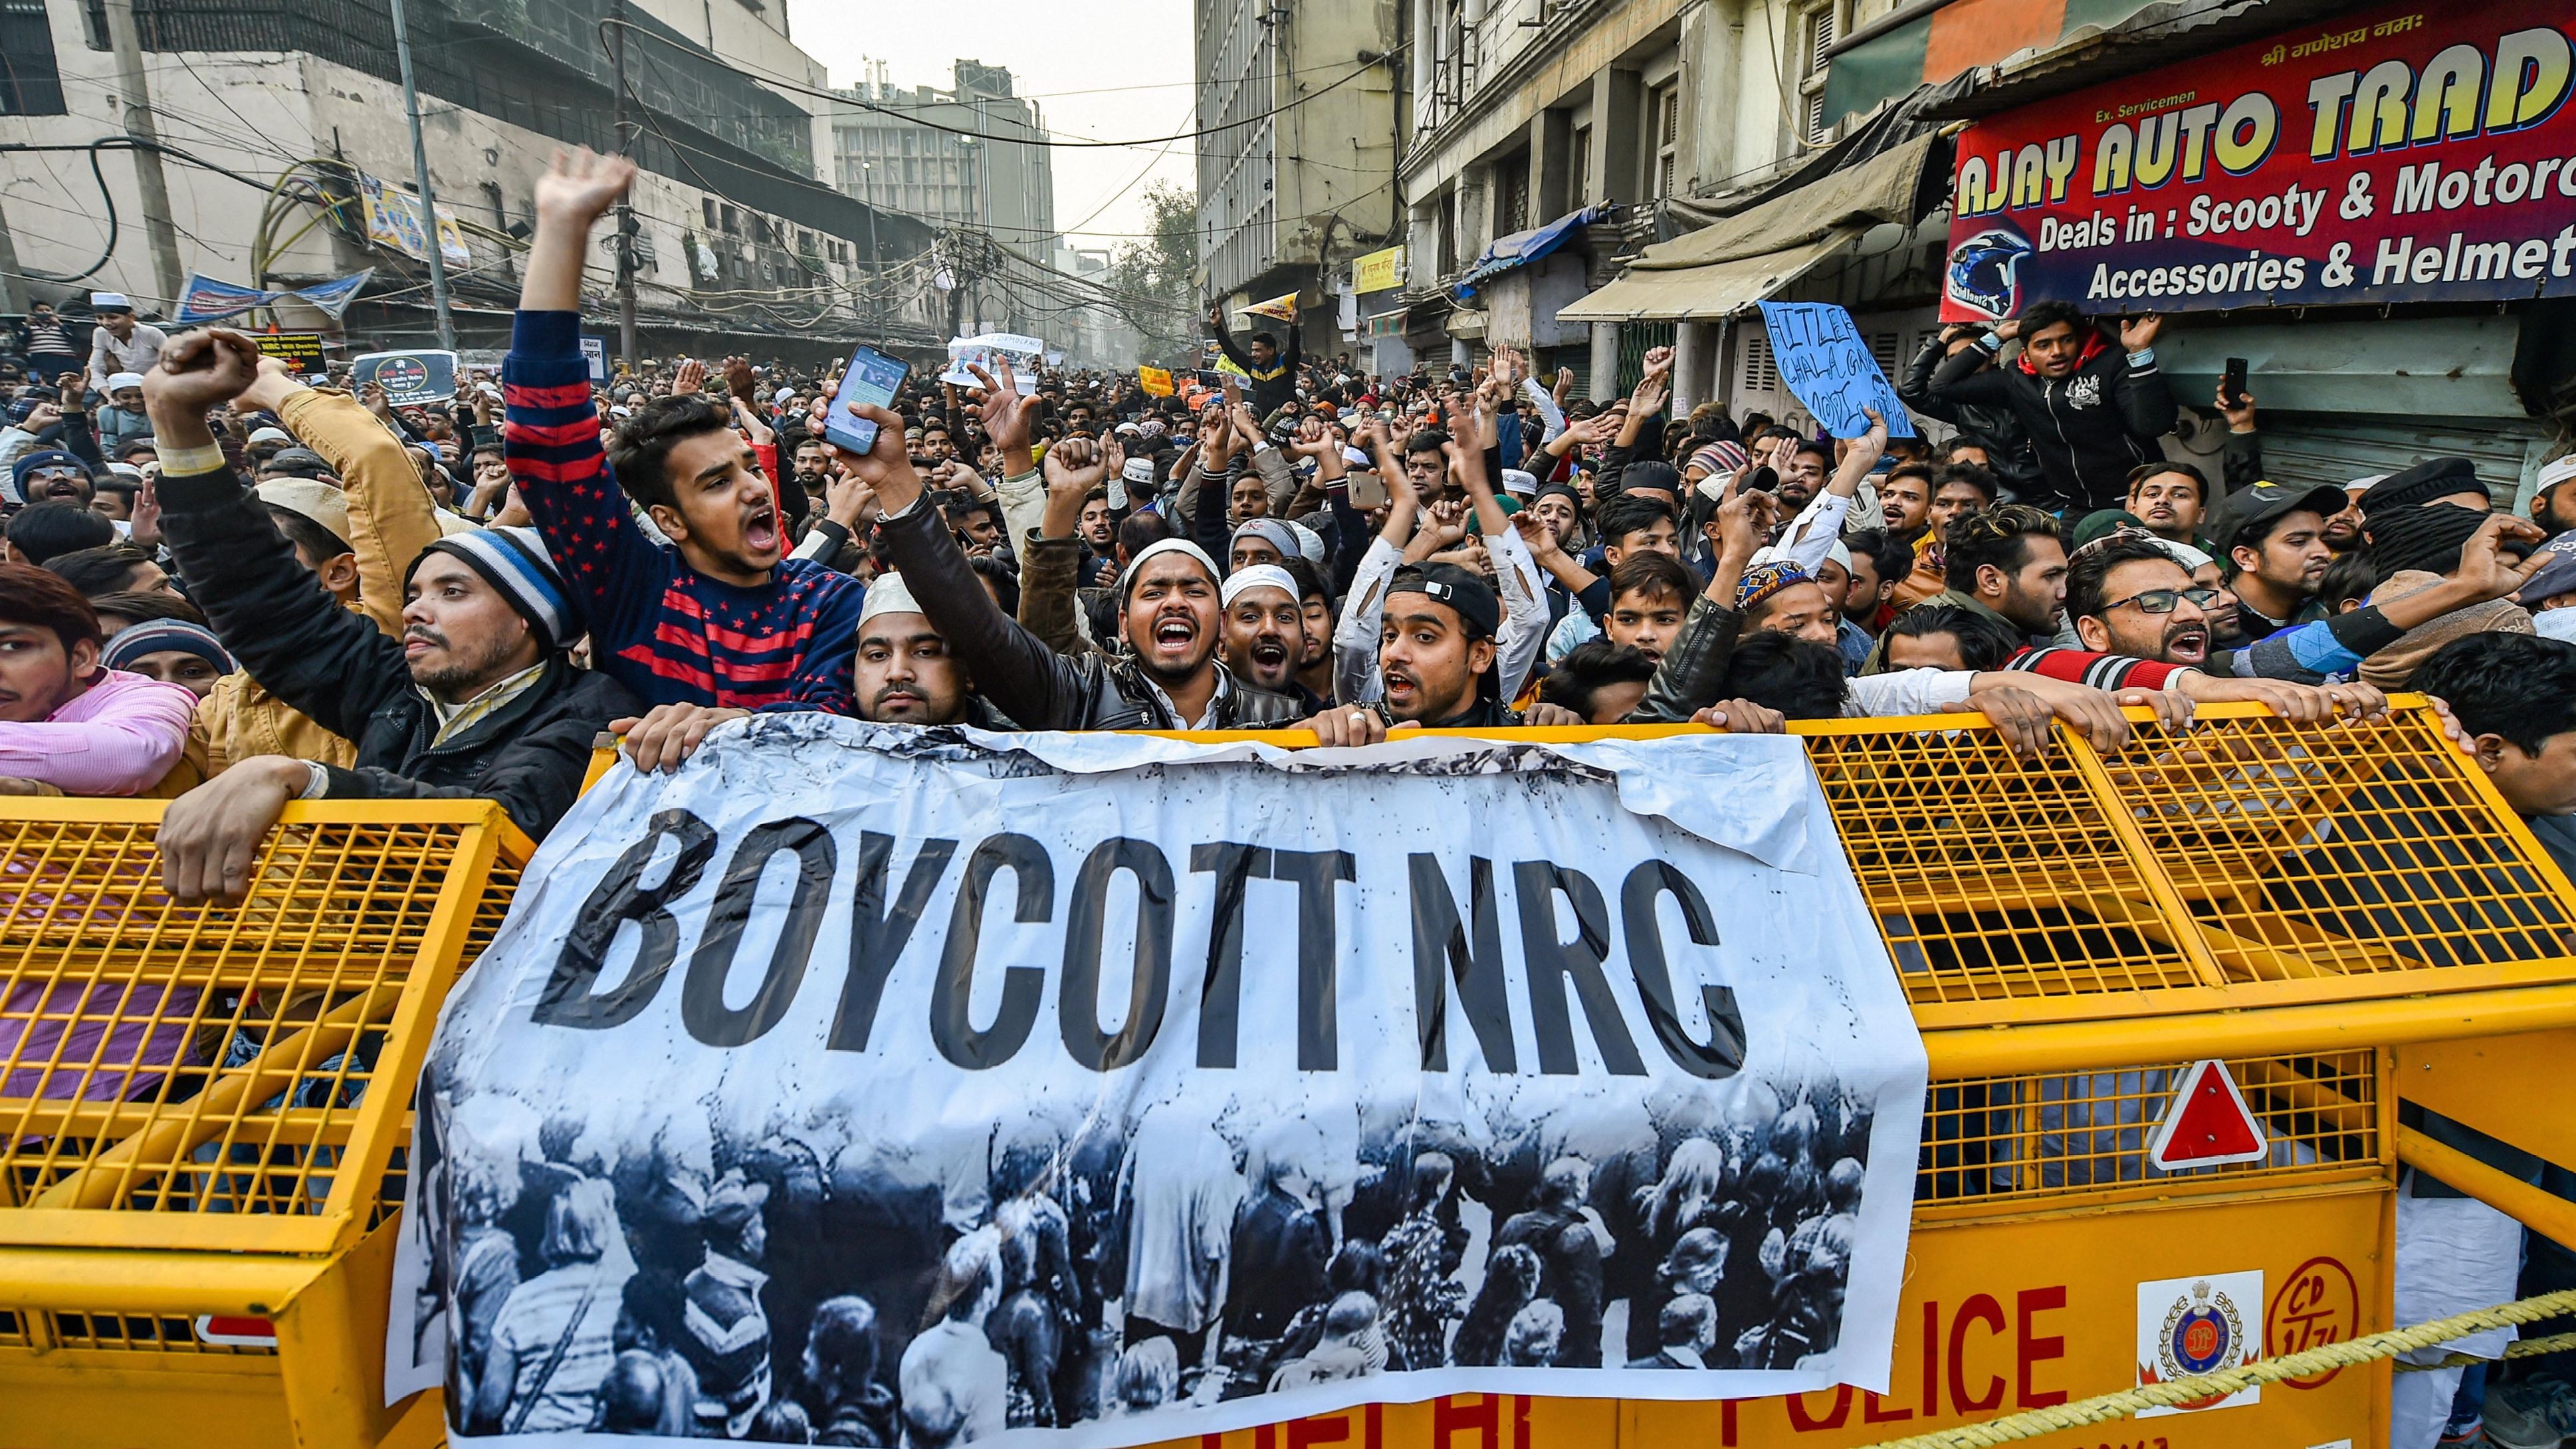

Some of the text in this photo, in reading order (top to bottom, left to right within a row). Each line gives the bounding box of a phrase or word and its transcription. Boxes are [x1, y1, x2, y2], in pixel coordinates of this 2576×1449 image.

[2261, 48, 2286, 66] श्री
[2375, 14, 2423, 37] नमः
[1957, 27, 2575, 219] AJAY AUTO TRAD
[2095, 90, 2196, 124] Ex. Servicemen
[2038, 210, 2117, 253] Deals
[2125, 205, 2156, 244] in
[2187, 182, 2327, 238] Scooty
[2339, 171, 2375, 221] &
[2086, 224, 2576, 301] Accessories & Helmet
[1267, 308, 1285, 317] NRC
[998, 335, 1042, 348] DEMOCRACY
[533, 807, 1747, 1081] BOYCOTT NRC
[2288, 1276, 2324, 1315] CD
